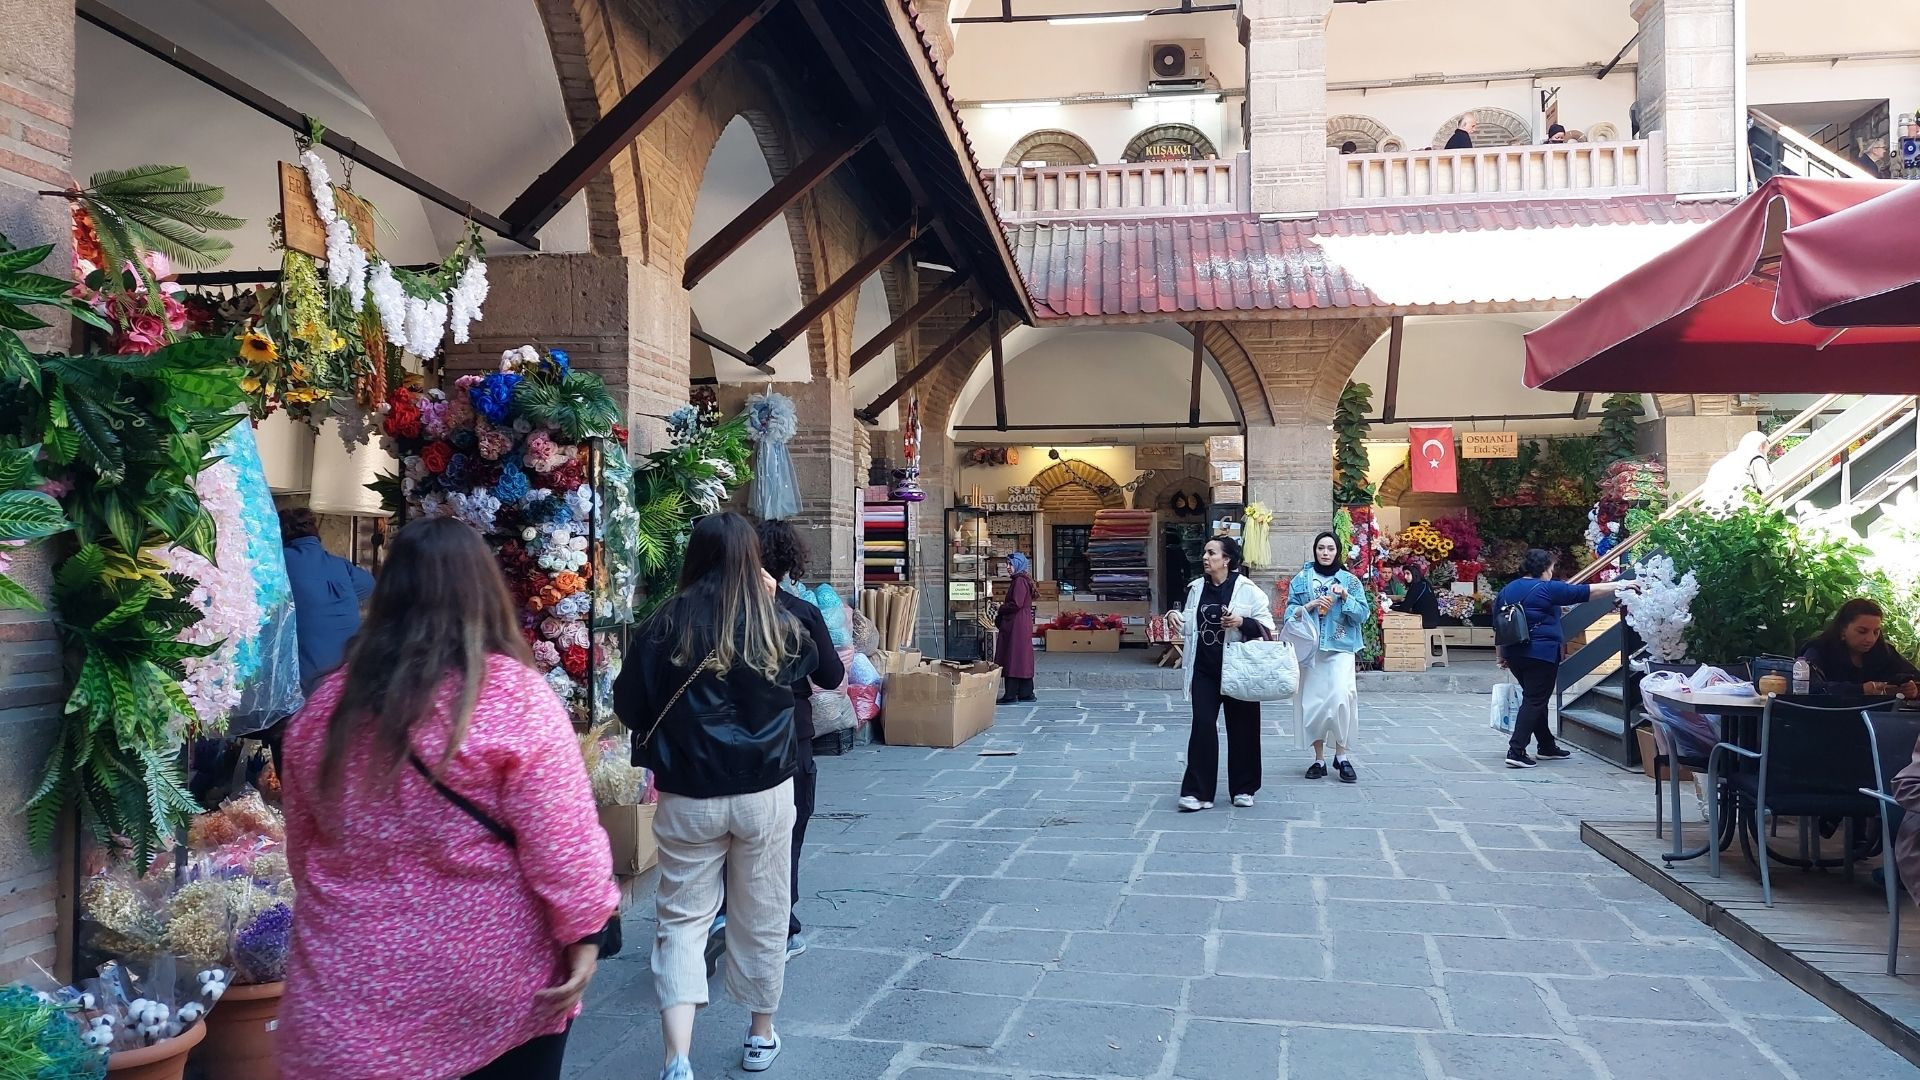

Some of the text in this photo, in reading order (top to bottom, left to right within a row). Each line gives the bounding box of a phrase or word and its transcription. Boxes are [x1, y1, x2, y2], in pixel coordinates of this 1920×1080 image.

[1145, 145, 1191, 158] KUŞAKÇI
[1466, 435, 1513, 444] OSMANLI
[1473, 445, 1490, 454] Ltd.
[748, 1050, 761, 1058] NIKE
